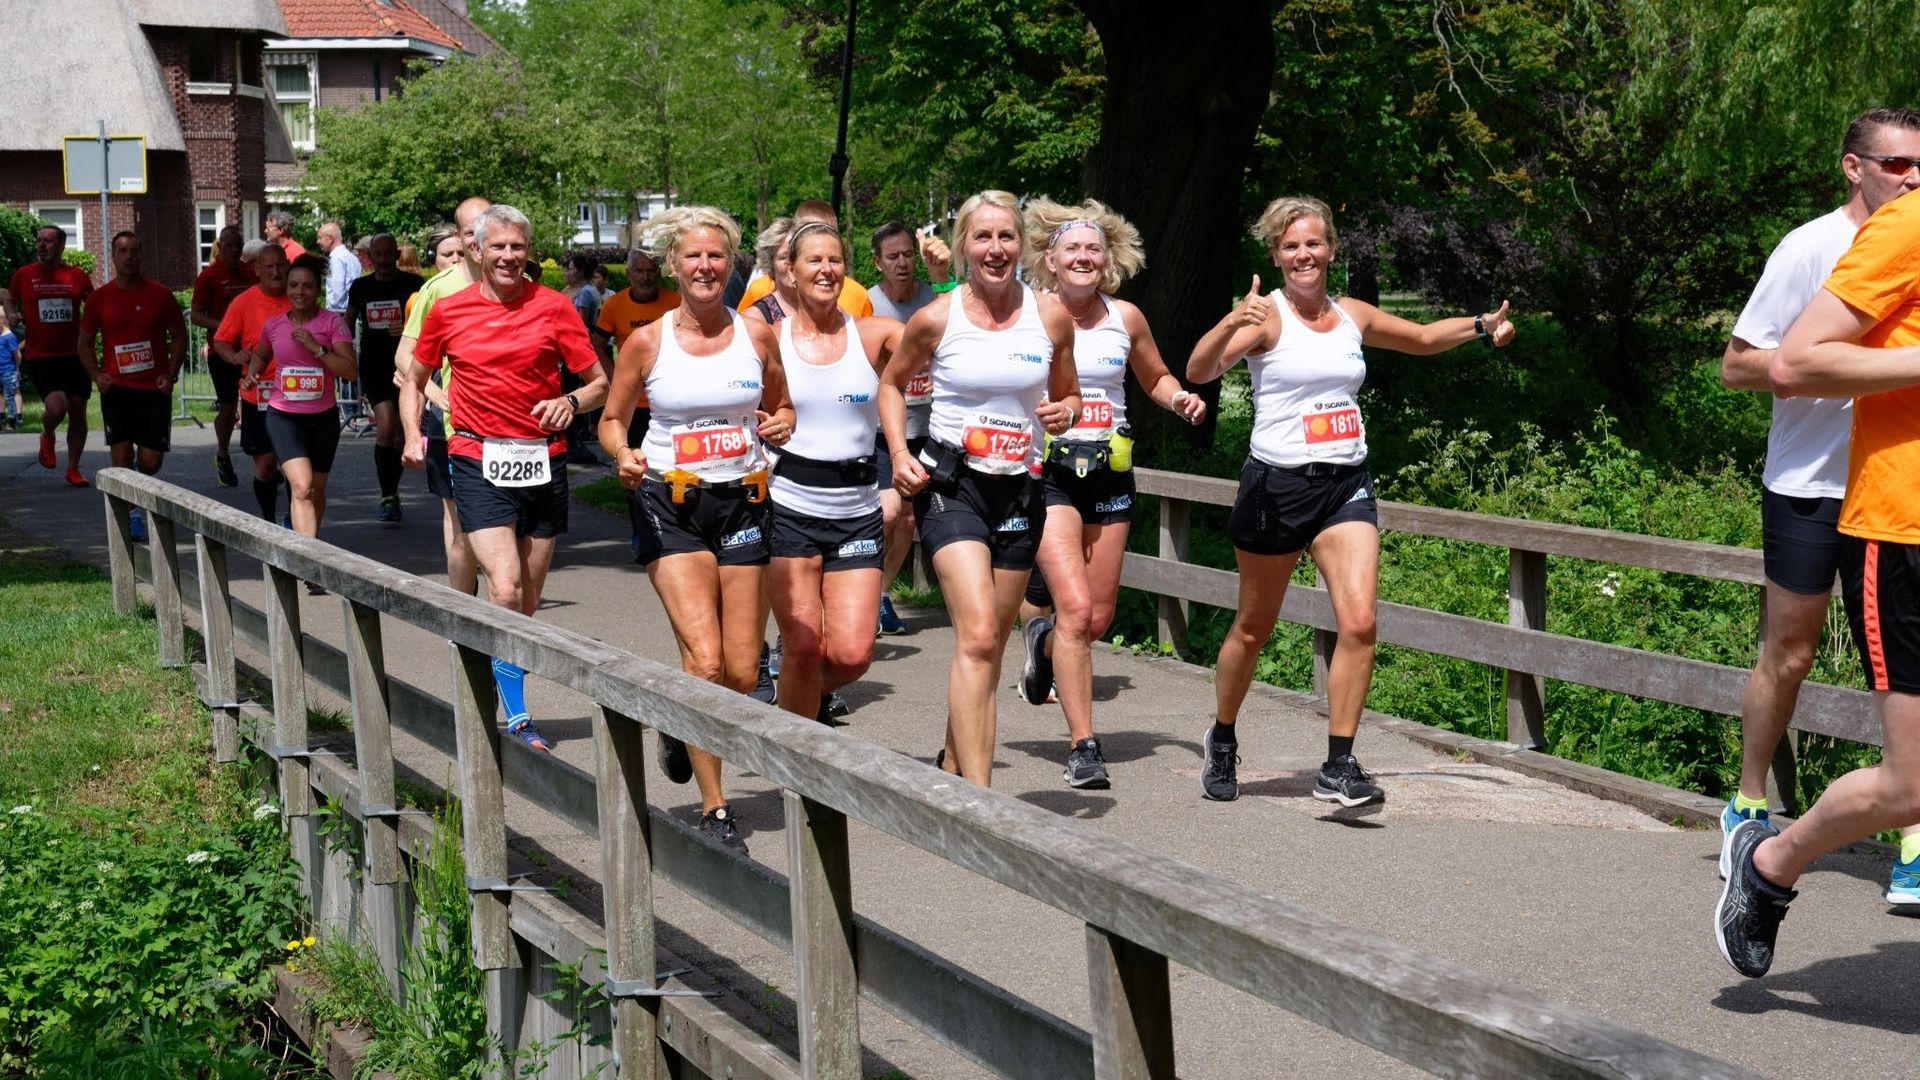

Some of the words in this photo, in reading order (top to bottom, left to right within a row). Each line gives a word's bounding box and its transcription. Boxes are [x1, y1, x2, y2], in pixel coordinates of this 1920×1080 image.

[42, 309, 71, 320] 92156
[630, 320, 654, 328] SCA
[300, 378, 317, 389] 998
[1081, 404, 1109, 422] 915
[696, 419, 729, 428] SCANIA
[989, 418, 1022, 429] SCANIA
[1330, 413, 1357, 435] 1817
[702, 431, 742, 455] 1768
[489, 460, 545, 481] 92288
[721, 528, 761, 547] Bakker
